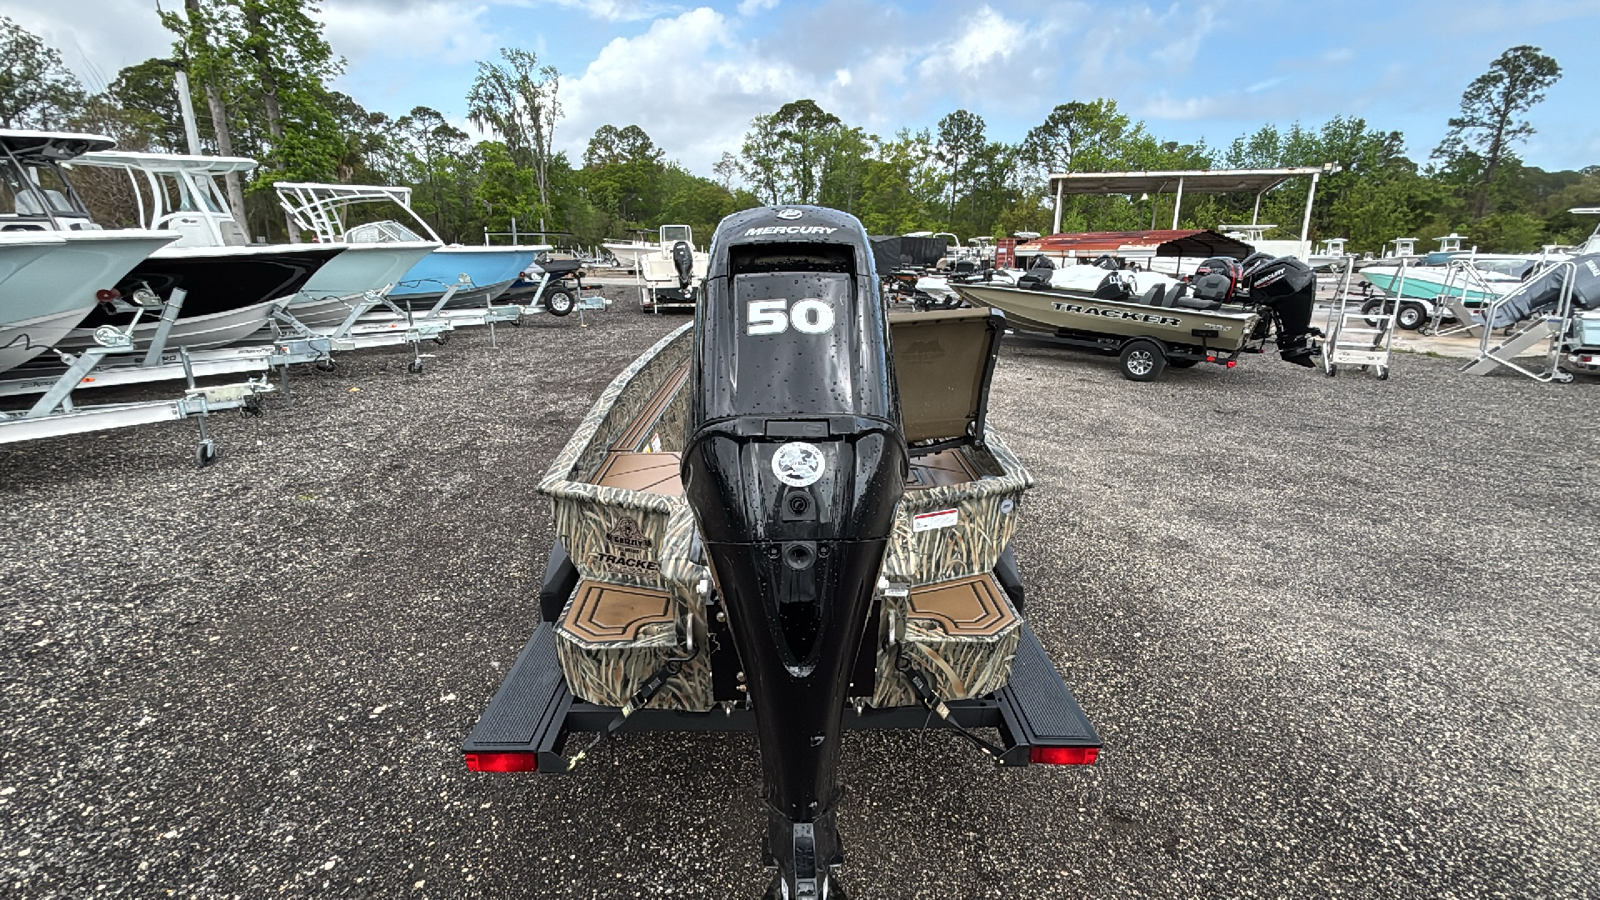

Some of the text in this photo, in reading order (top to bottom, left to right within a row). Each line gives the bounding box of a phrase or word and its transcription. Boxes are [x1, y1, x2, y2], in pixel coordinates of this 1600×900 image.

[744, 226, 837, 236] MERCURY
[747, 298, 835, 336] 50
[1051, 301, 1181, 327] TRACKER
[614, 537, 643, 547] GRIZZLY
[598, 553, 659, 571] TRACKE
